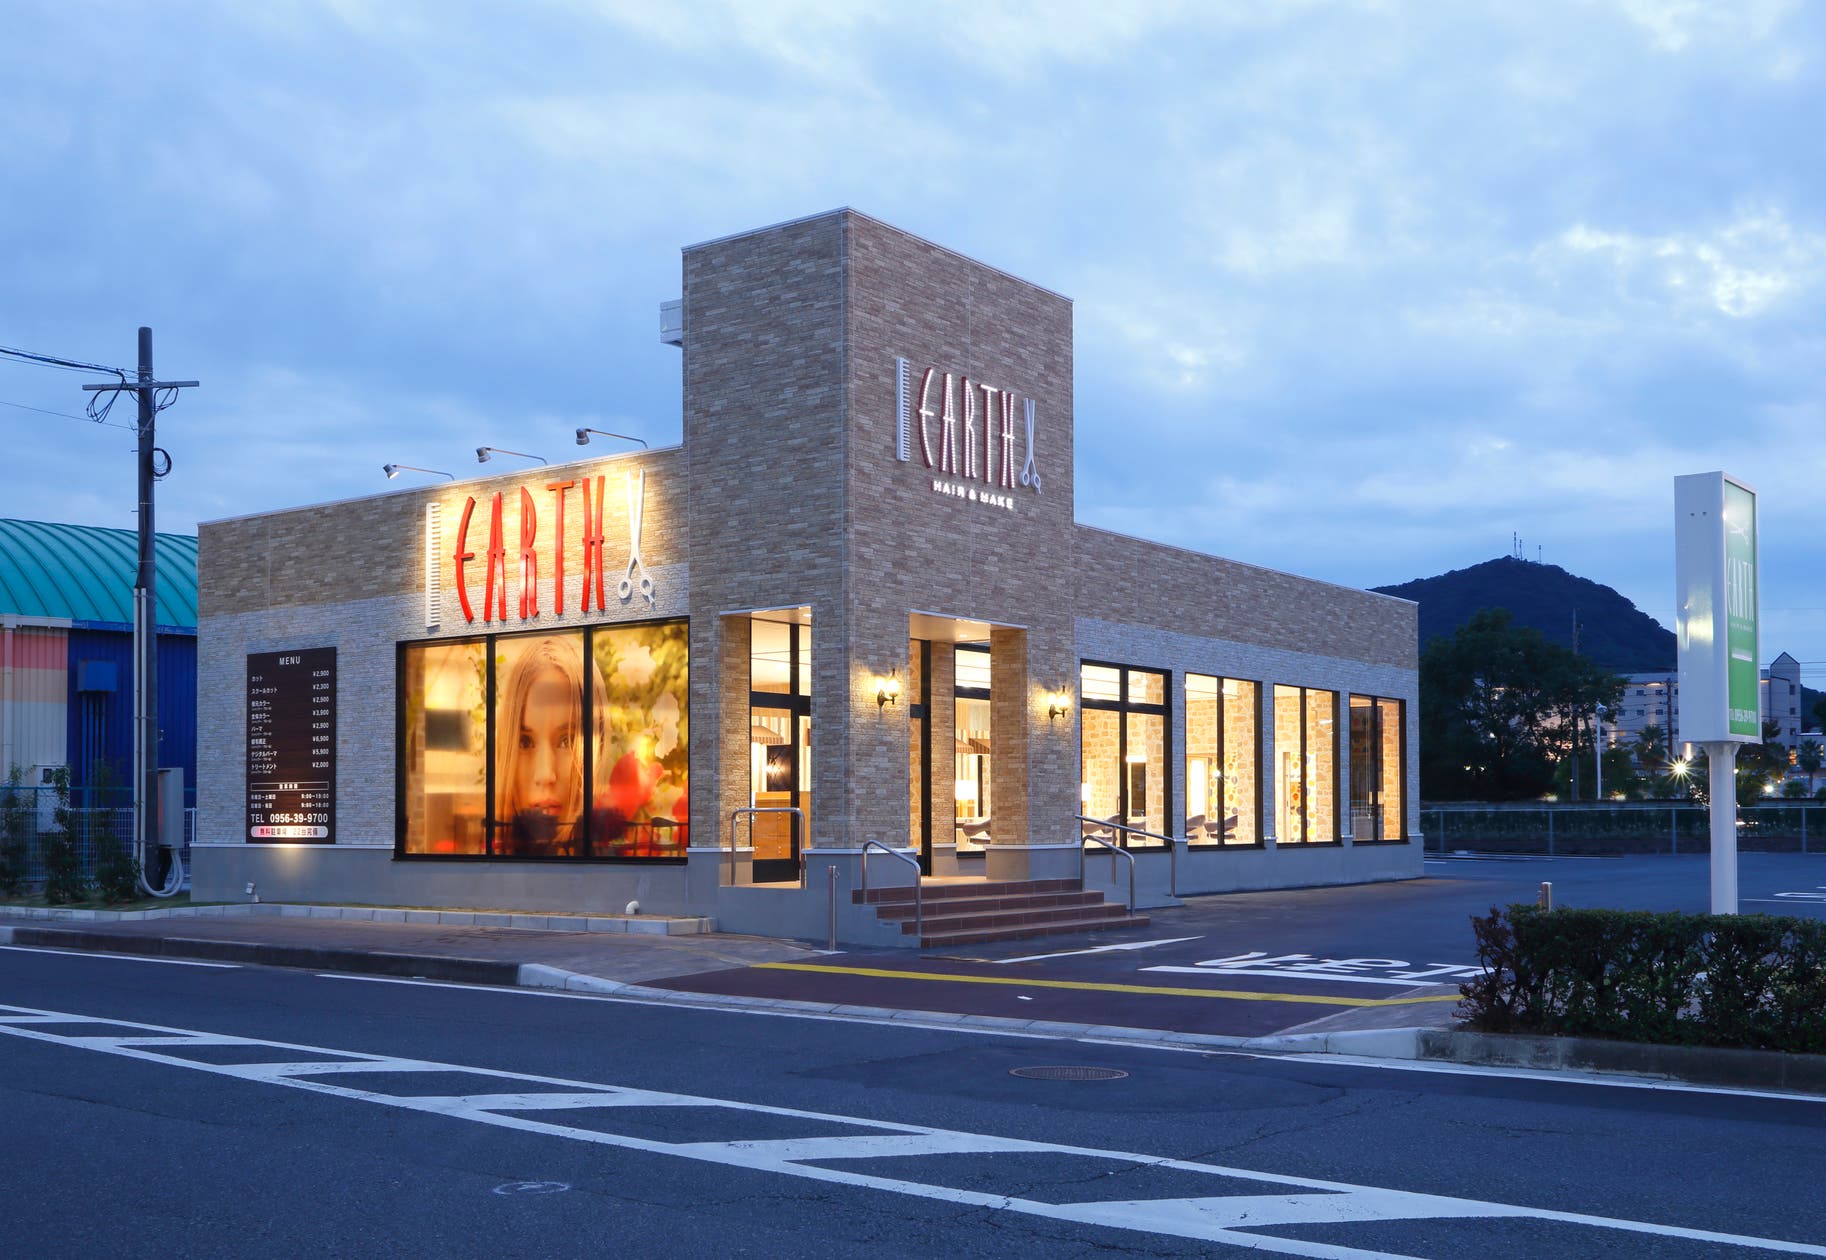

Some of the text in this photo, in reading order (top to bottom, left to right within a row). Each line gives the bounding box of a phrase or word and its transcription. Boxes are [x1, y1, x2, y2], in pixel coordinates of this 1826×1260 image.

[916, 367, 1015, 489] EARTH
[931, 480, 1013, 510] HAIR & MAKE
[453, 475, 605, 623] EARTH
[279, 656, 301, 665] MENU
[250, 813, 328, 823] TEL 0956-39-9700
